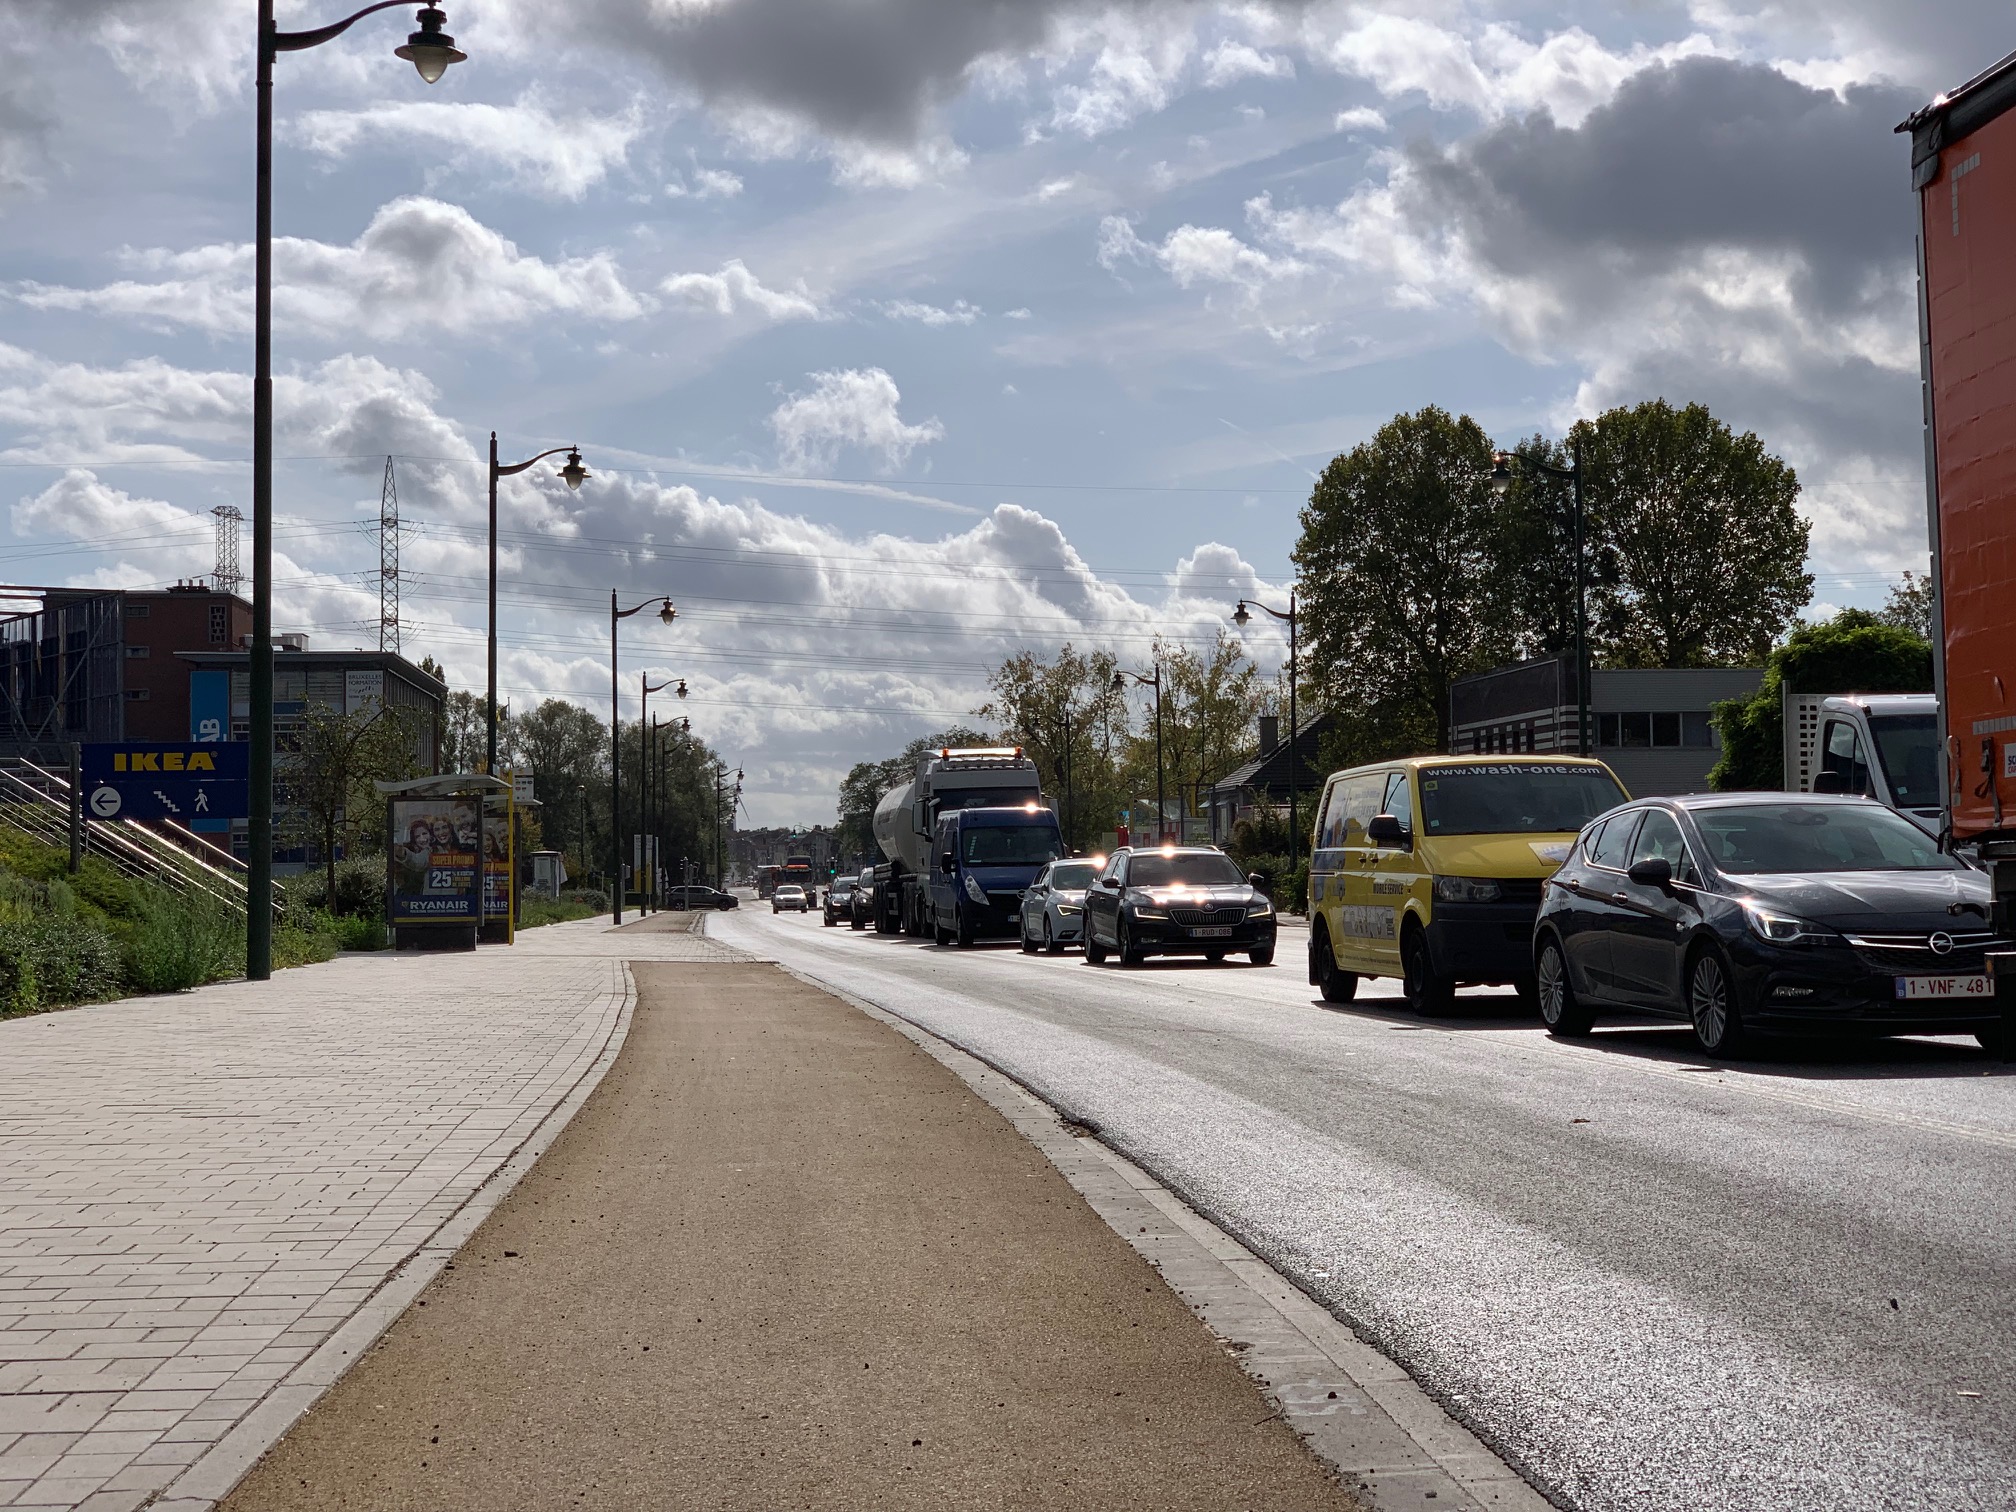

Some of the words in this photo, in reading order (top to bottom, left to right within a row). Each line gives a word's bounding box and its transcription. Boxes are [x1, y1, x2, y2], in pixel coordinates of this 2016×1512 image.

[114, 752, 216, 772] IKEA
[1426, 764, 1600, 776] www.wash-one.com
[432, 855, 452, 865] SUPER
[452, 855, 475, 864] PROMO
[431, 871, 452, 887] 25
[1387, 883, 1403, 895] SERVICE
[409, 901, 469, 910] RYANAIR
